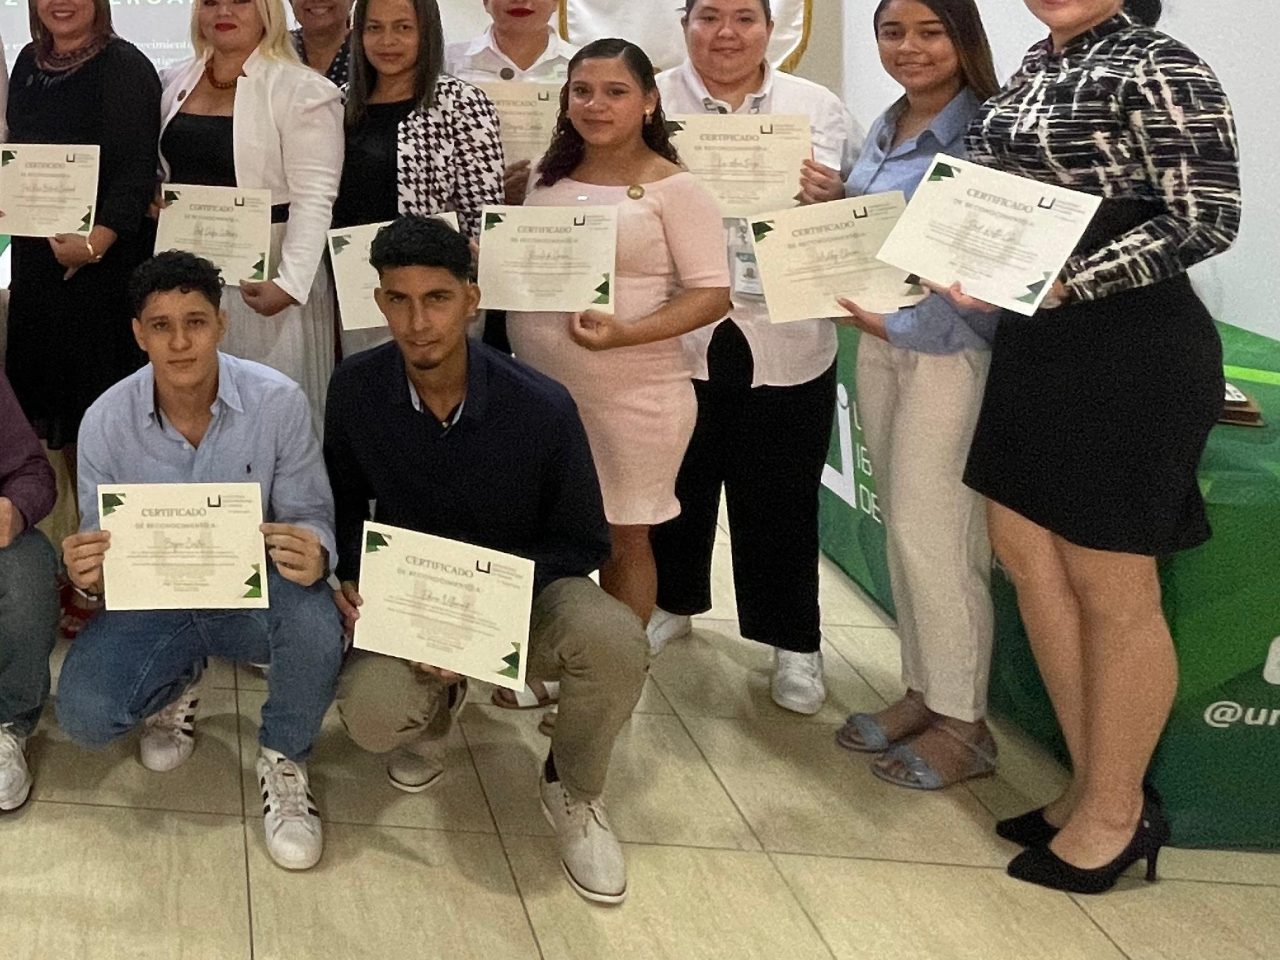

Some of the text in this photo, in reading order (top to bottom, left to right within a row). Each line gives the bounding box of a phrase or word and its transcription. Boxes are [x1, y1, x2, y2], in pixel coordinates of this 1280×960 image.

[966, 188, 1033, 213] CERTIFICADO
[791, 220, 856, 237] CERTIFICADO
[141, 508, 207, 517] CERTIFICADO
[860, 484, 882, 524] DE
[405, 555, 474, 578] CERTIFICADO
